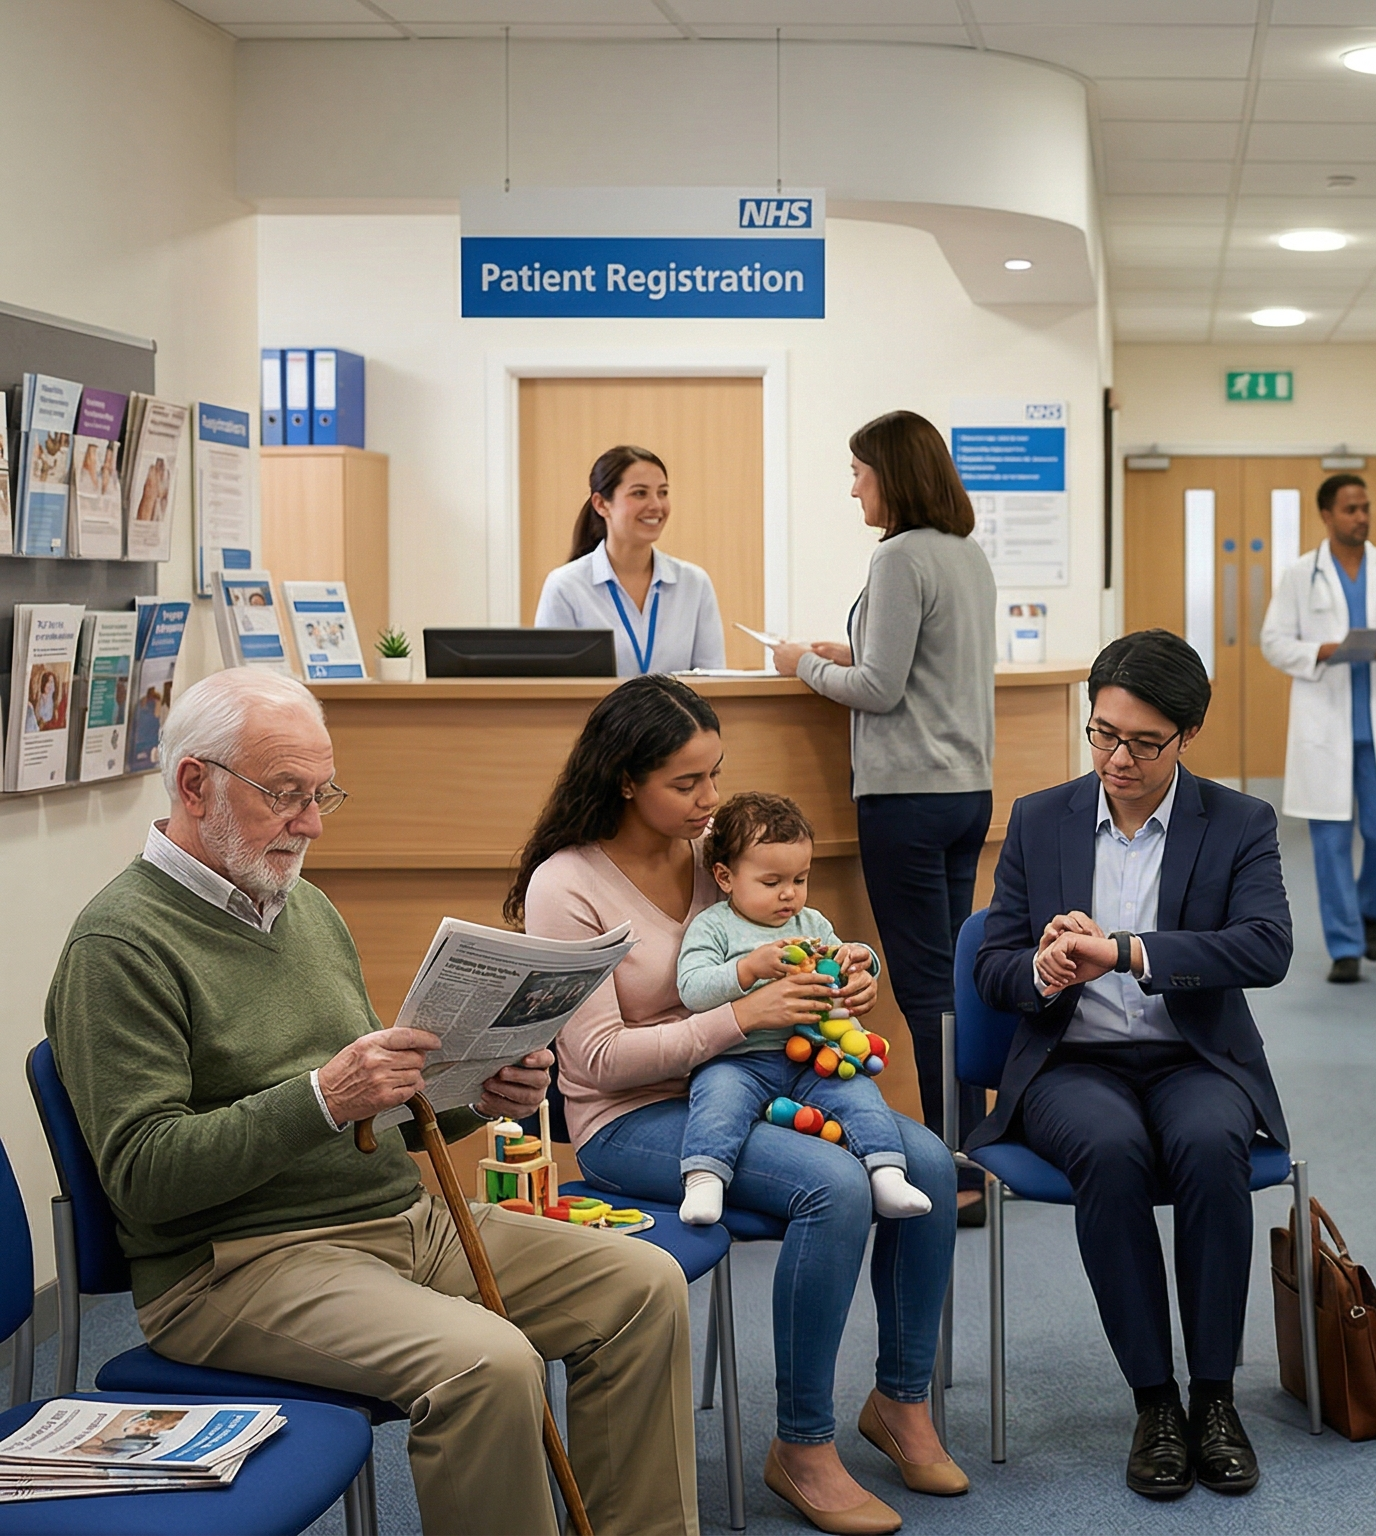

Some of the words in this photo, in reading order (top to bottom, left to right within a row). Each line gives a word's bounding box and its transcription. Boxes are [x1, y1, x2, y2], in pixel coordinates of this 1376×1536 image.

[741, 200, 809, 226] NHS
[481, 262, 597, 292] Patient
[606, 262, 805, 300] Registration
